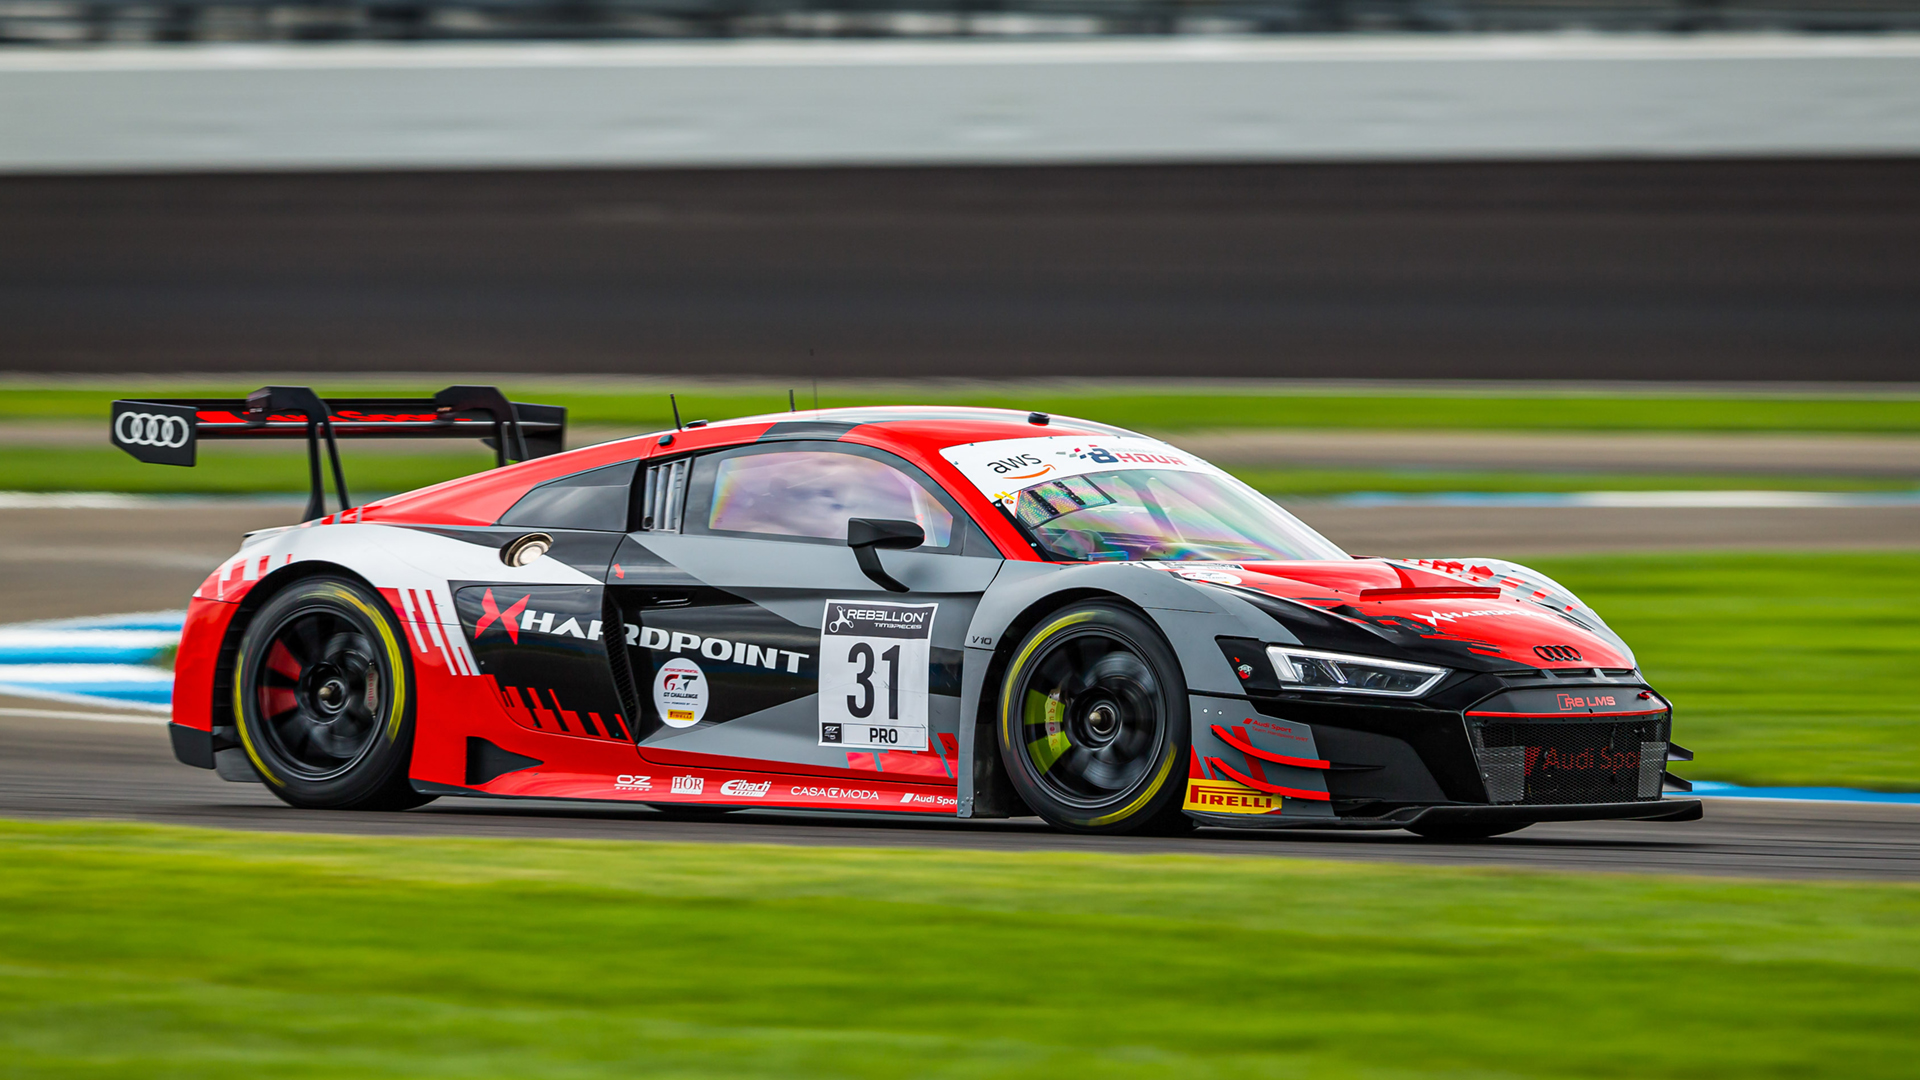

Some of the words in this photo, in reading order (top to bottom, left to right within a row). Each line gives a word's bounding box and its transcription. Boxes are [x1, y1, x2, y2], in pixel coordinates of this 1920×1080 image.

[987, 453, 1042, 474] aws
[1115, 453, 1187, 466] HOUR
[847, 609, 924, 623] REBELLION
[847, 642, 900, 720] 31
[1564, 697, 1585, 708] R8
[1587, 696, 1616, 707] LMS
[1252, 720, 1270, 728] Audi
[1271, 723, 1292, 733] Sport
[870, 728, 898, 743] PRO
[1542, 747, 1594, 770] Audi
[617, 774, 651, 785] OZ
[913, 794, 934, 803] Audi
[936, 795, 958, 805] Spor
[1190, 785, 1274, 809] PIRELLI
